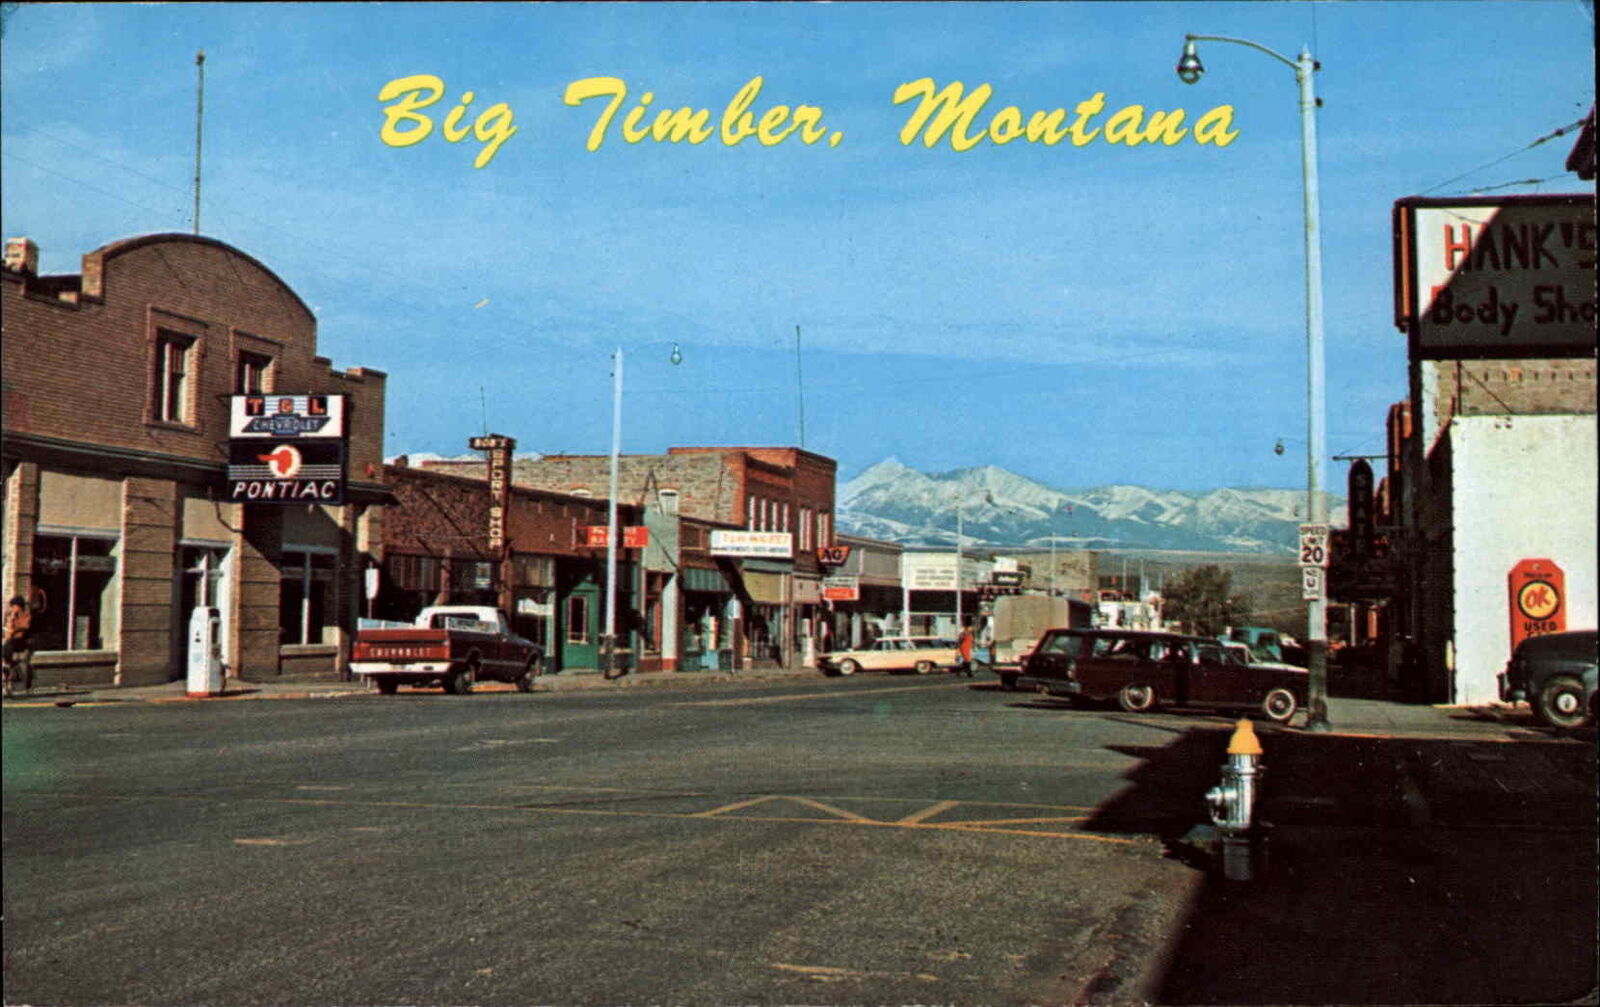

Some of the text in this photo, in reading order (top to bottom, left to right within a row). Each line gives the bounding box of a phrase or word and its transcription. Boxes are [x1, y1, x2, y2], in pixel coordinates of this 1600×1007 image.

[1430, 283, 1519, 336] Body
[232, 481, 335, 499] PONTIAC
[1302, 546, 1323, 563] 20
[1524, 586, 1551, 609] OK
[1524, 621, 1558, 632] USED
[369, 648, 431, 657] CHEVROLET
